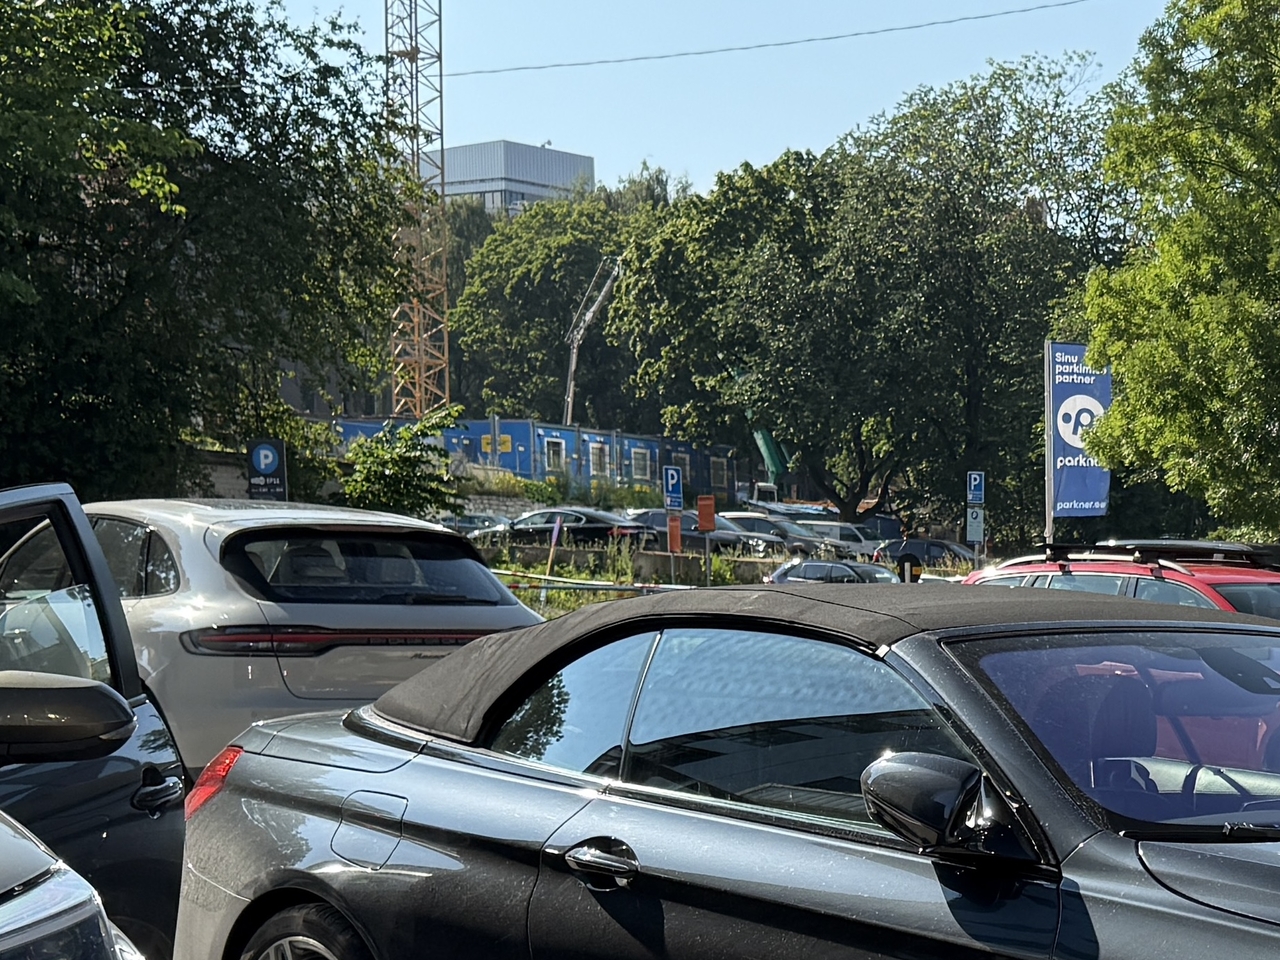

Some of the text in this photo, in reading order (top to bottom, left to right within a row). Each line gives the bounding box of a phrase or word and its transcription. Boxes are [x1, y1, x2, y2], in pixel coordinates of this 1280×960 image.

[1055, 352, 1078, 363] Sinu
[1055, 374, 1096, 384] partner
[259, 449, 274, 470] P
[667, 469, 679, 492] P
[970, 474, 981, 491] P
